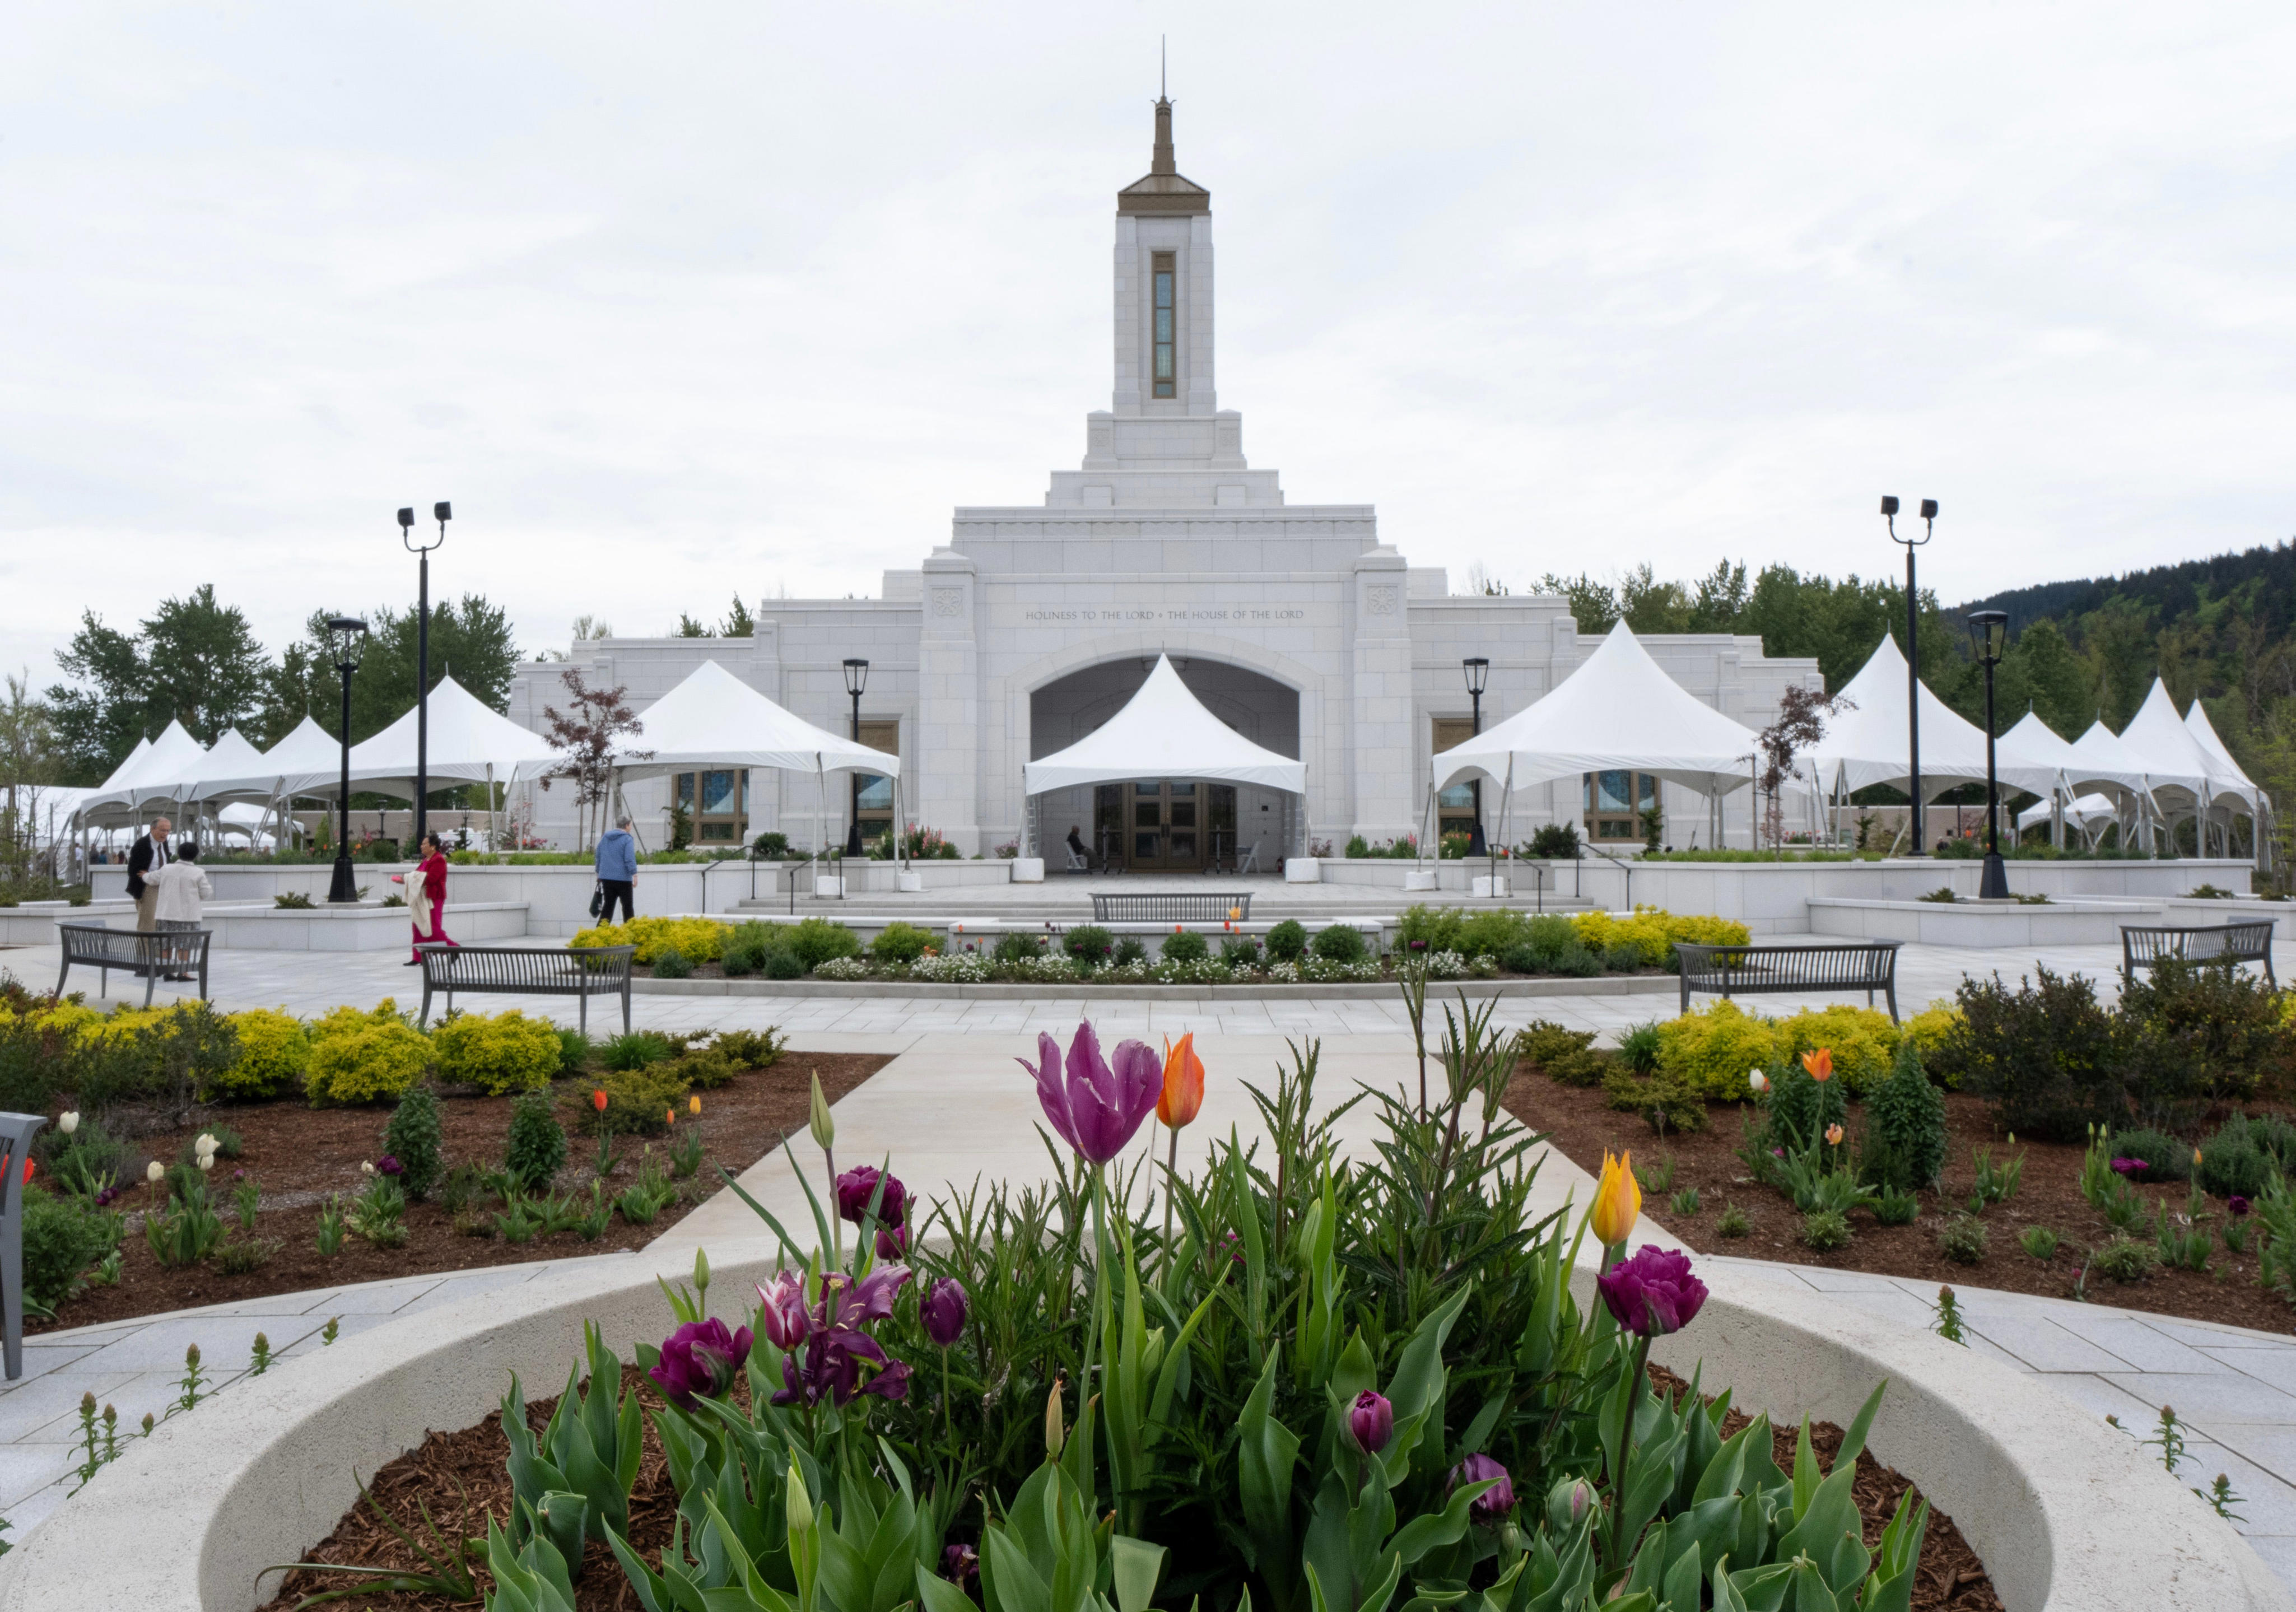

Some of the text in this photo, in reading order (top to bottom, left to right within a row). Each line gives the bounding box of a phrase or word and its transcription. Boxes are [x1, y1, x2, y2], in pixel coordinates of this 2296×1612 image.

[1026, 610, 1303, 619] HOLINESS TO THE LORD THE HOUSE OF THE LORD
